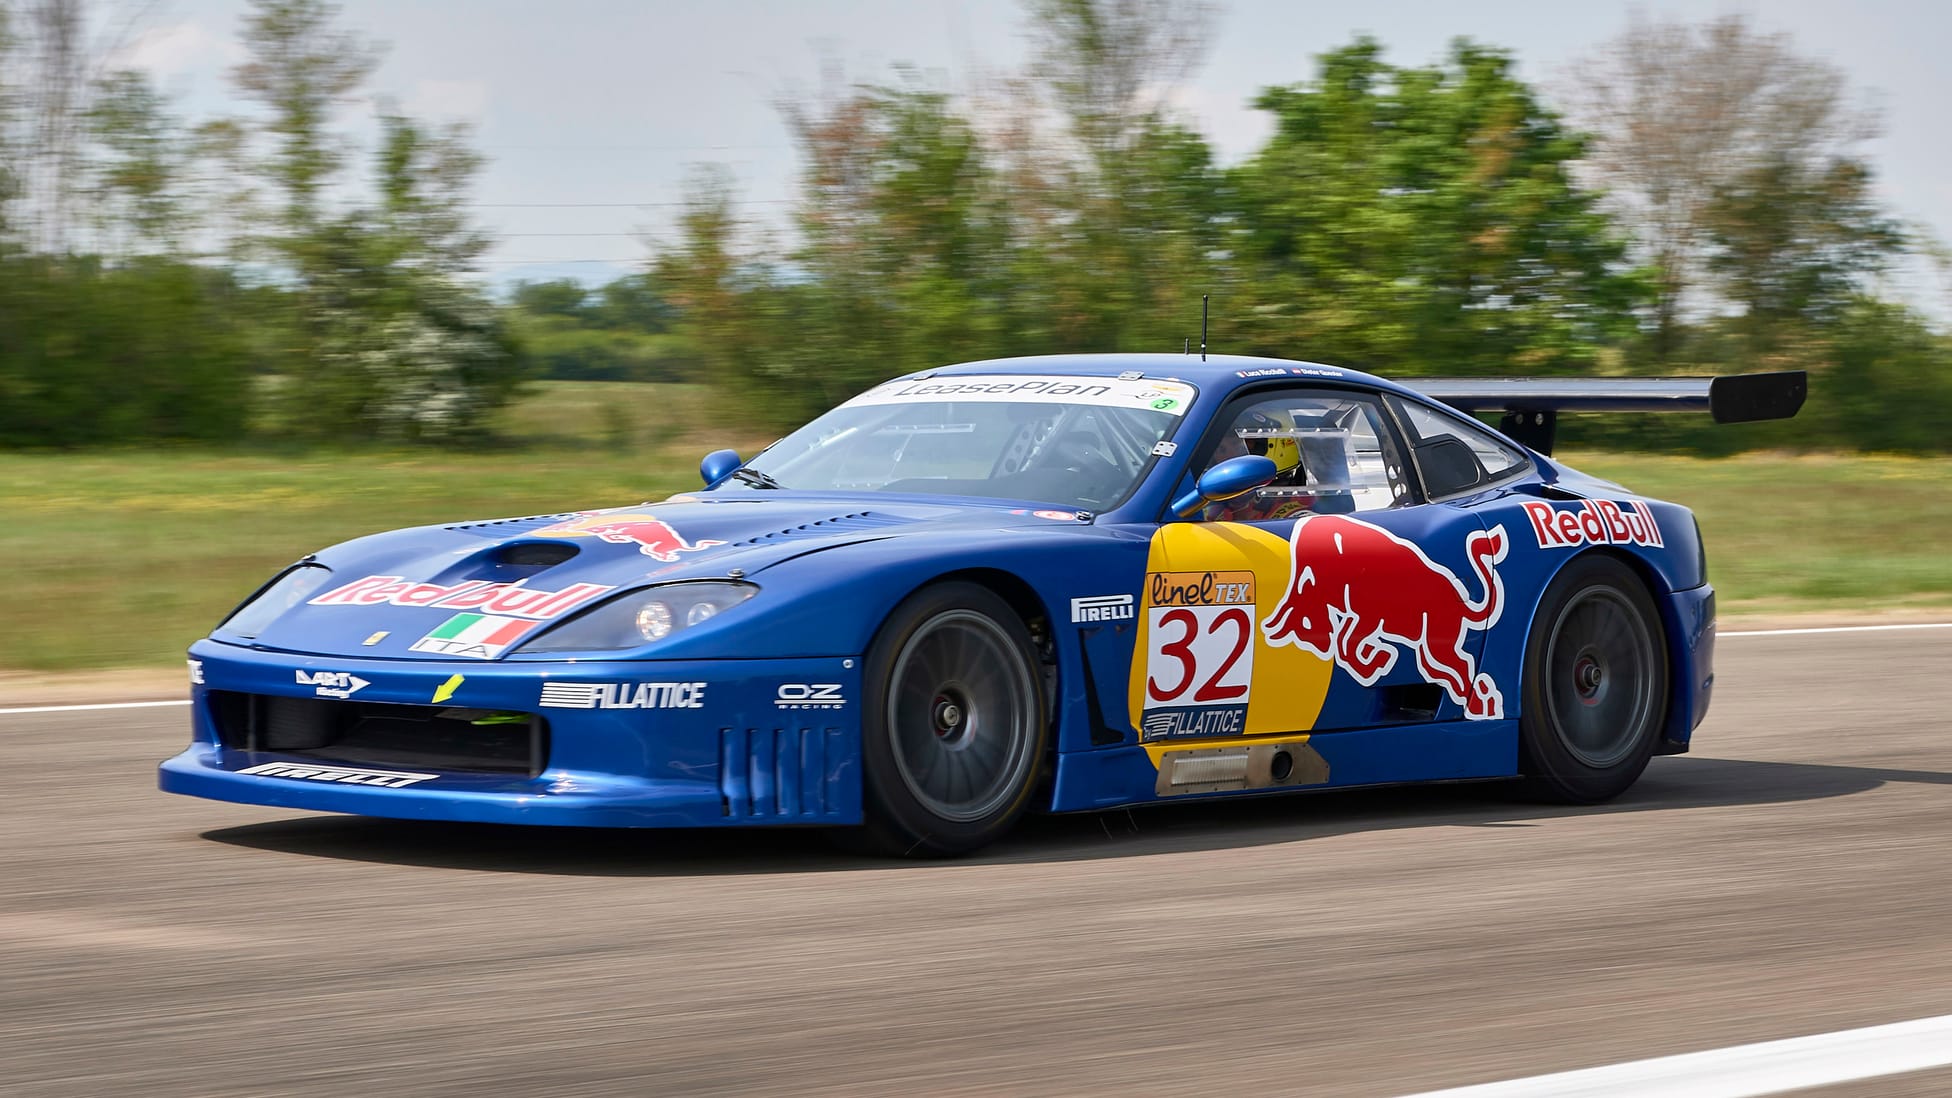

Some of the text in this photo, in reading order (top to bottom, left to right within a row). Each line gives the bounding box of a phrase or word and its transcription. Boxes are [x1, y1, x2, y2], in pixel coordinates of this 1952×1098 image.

[897, 379, 1111, 397] LeasePlan
[1154, 399, 1174, 409] 3
[1071, 594, 1134, 623] PIRELLI
[415, 639, 489, 657] ITA
[1148, 608, 1251, 702] 32
[588, 682, 707, 709] FILLATTICE
[777, 684, 842, 699] OZ
[1165, 709, 1243, 736] FILLATTICE
[234, 761, 440, 788] PIRELLI
